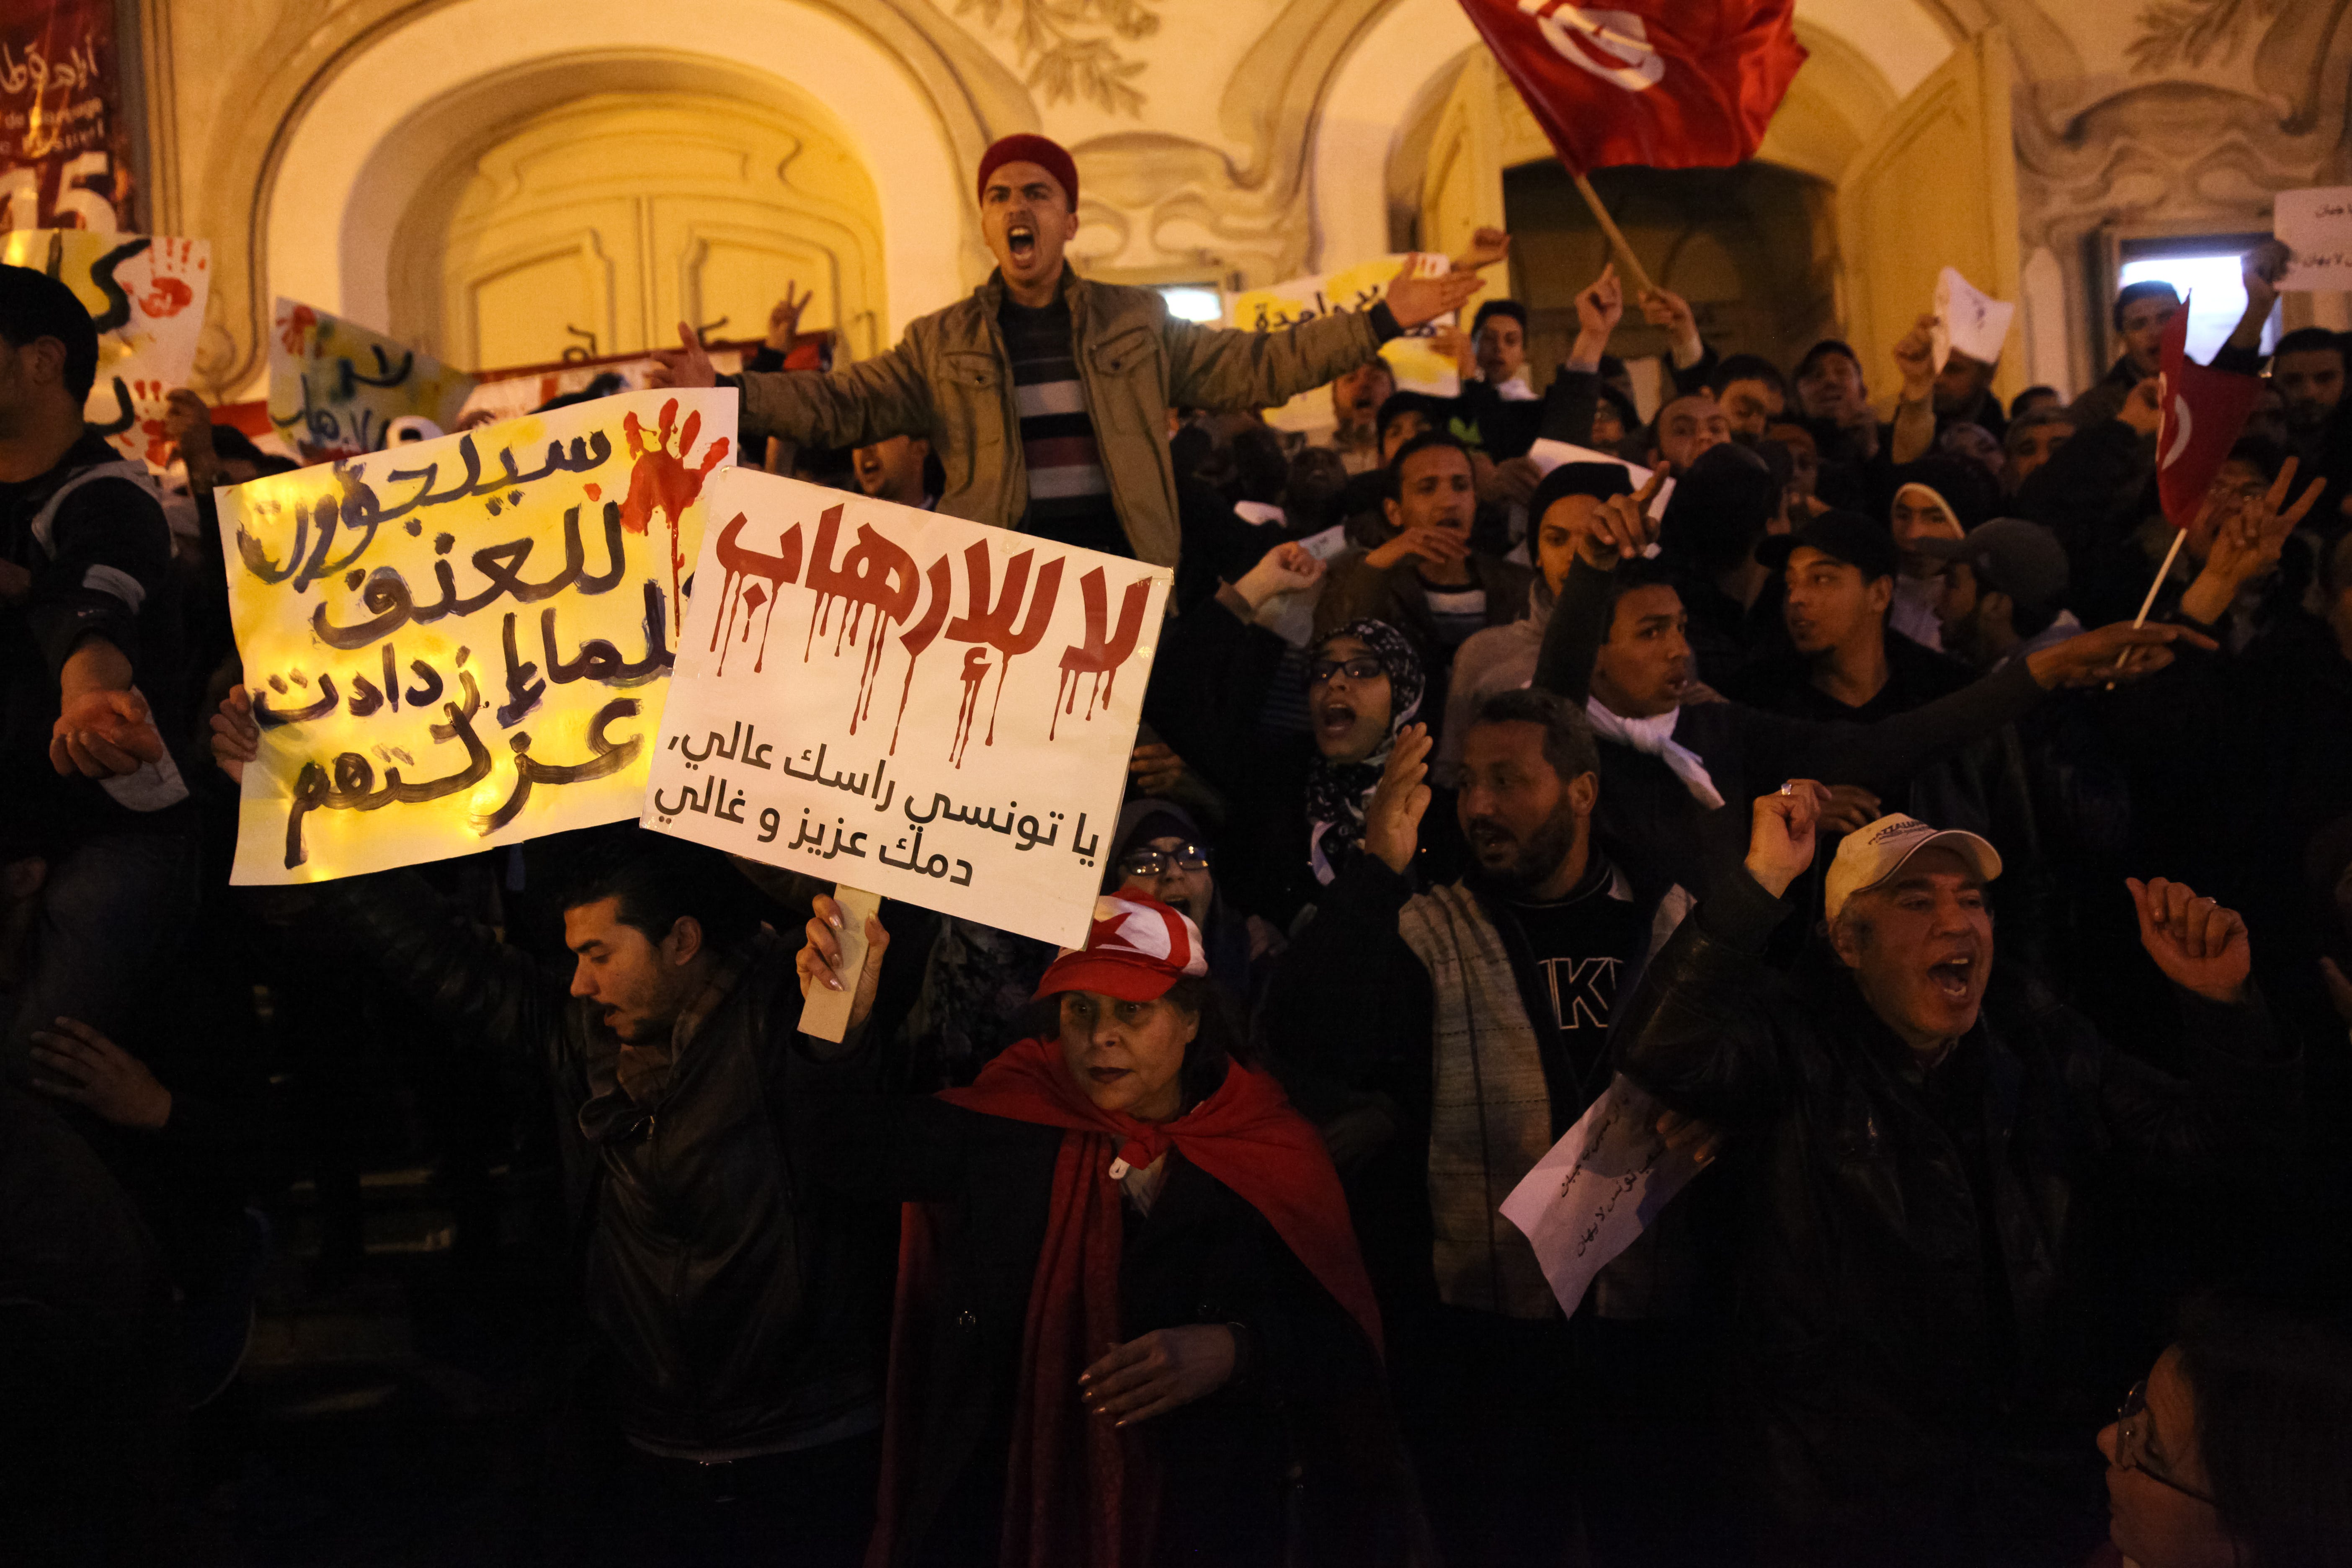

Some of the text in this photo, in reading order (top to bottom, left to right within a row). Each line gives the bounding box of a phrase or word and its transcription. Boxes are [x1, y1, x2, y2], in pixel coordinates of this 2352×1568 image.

[310, 500, 627, 651] للعنف
[540, 570, 695, 689] لما
[1057, 565, 1153, 675] لا
[284, 697, 647, 871] عزلتهم
[654, 774, 973, 887] دمك عزيز و غالي
[783, 743, 896, 812] راسك
[904, 792, 1065, 851] تونسي
[1071, 812, 1099, 867] يا
